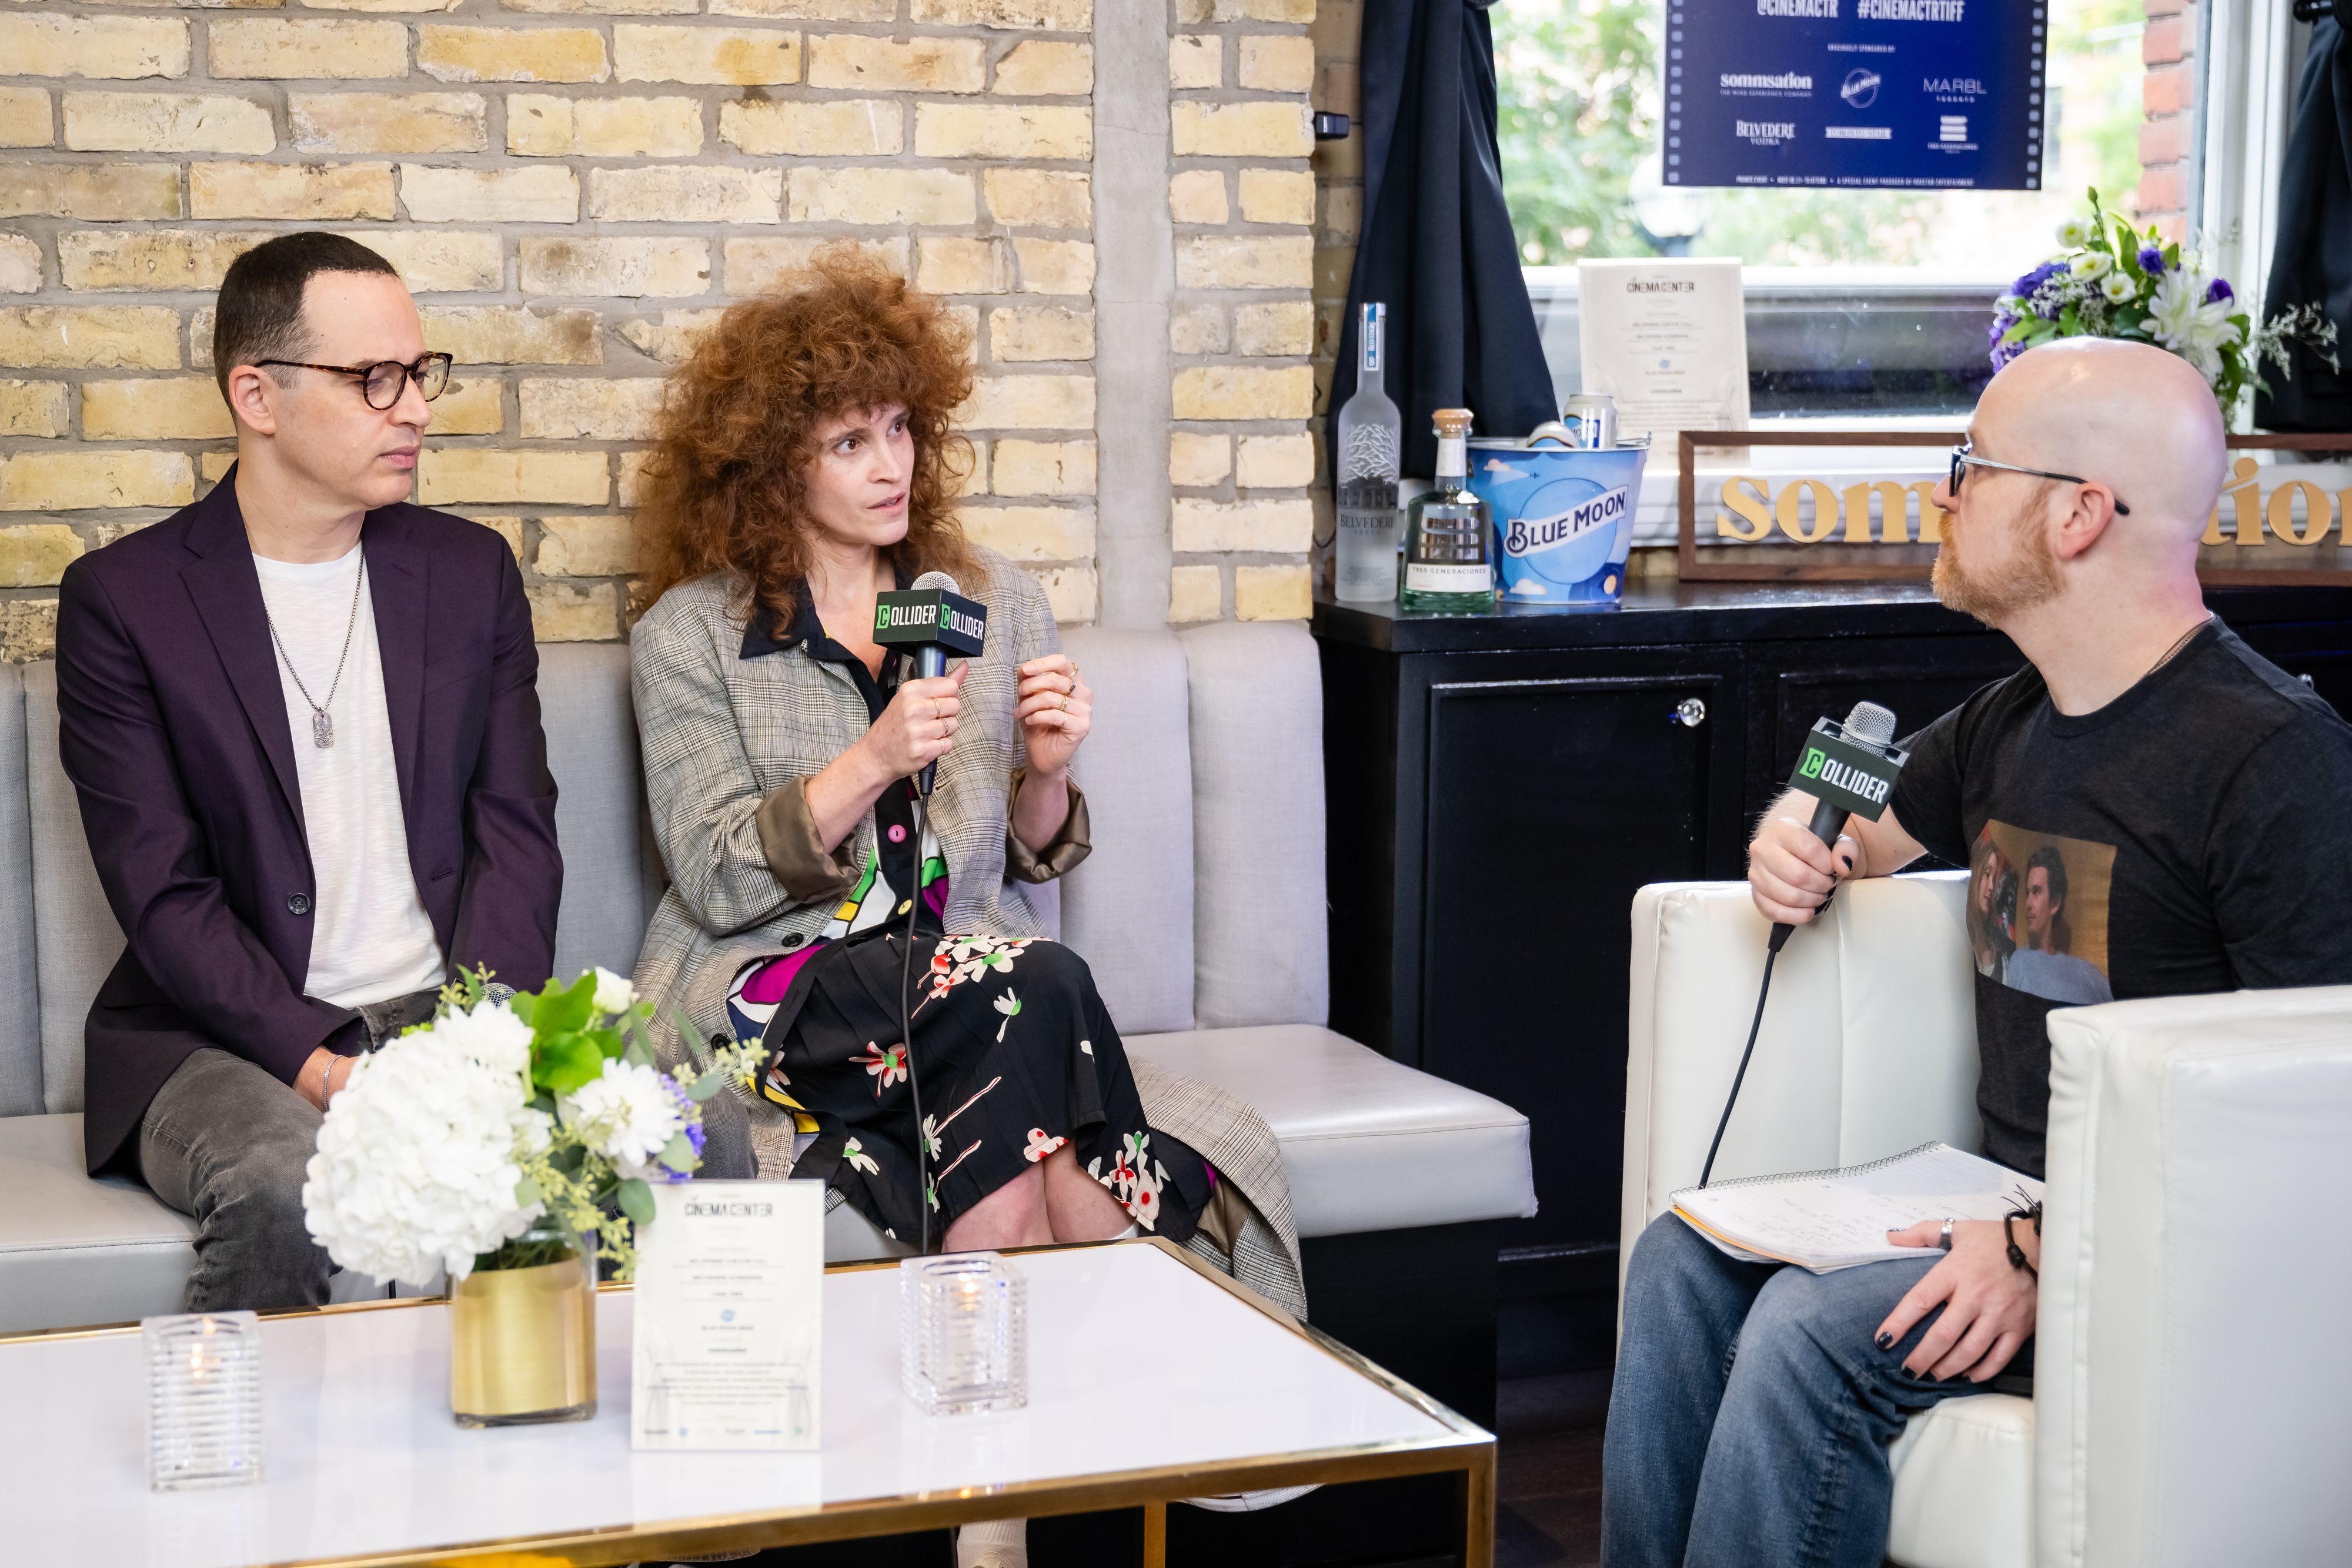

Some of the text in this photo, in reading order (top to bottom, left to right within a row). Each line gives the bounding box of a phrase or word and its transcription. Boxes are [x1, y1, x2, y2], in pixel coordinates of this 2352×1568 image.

[1720, 71, 1813, 89] sommsation
[1860, 74, 1881, 88] MOON
[1923, 78, 1987, 94] MARBL
[1736, 119, 1796, 140] BELVEDERE
[1750, 137, 1780, 145] VODKA
[1627, 282, 1695, 293] CINEMA CENTER
[1340, 514, 1394, 530] BELVEDERE
[1506, 491, 1626, 553] BLUE MOON
[878, 605, 937, 627] COLLIDER
[941, 606, 984, 640] COLLIDER
[1803, 750, 1889, 804] COLLIDER
